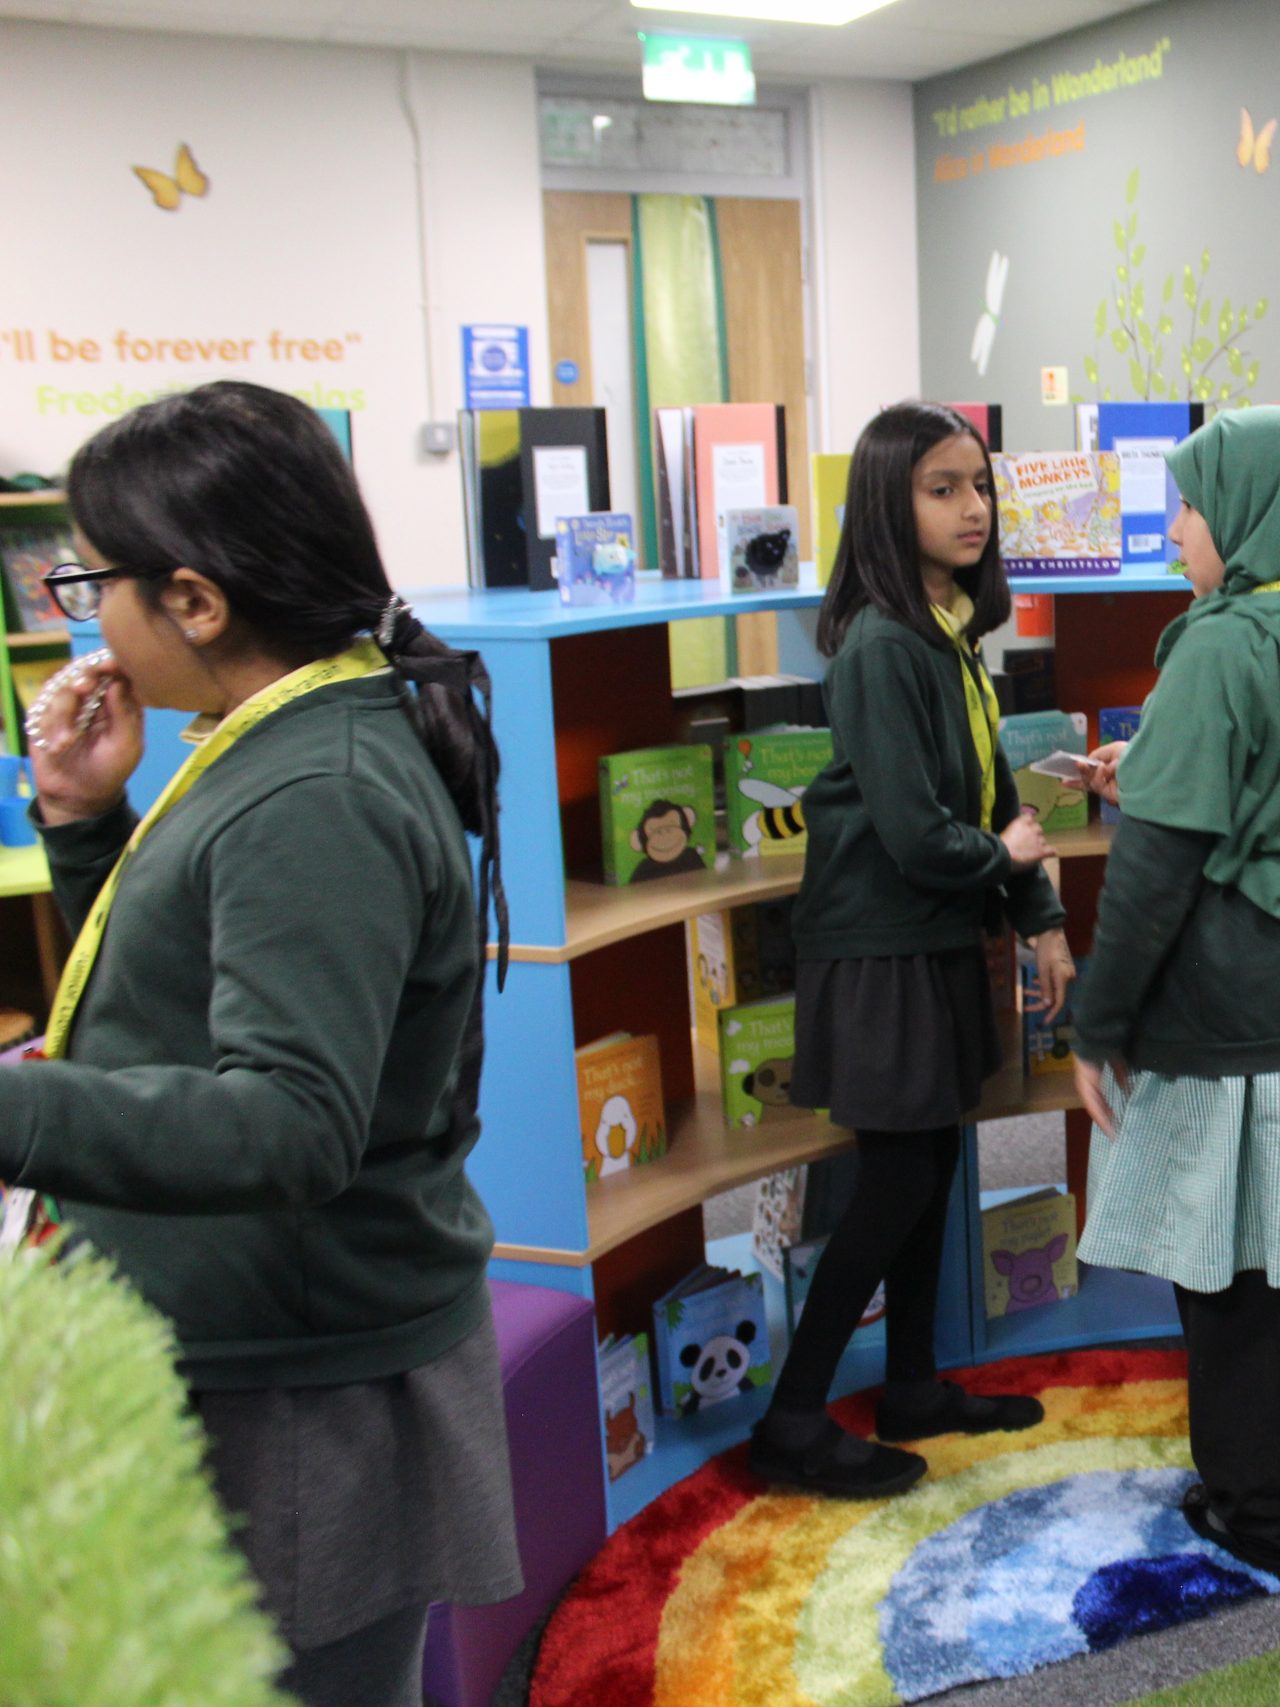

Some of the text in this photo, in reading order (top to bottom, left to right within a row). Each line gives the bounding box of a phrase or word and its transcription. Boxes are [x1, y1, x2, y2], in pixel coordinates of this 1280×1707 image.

[47, 328, 101, 363] be
[113, 329, 256, 363] forever
[268, 328, 362, 363] free"
[1015, 461, 1048, 478] FIVE
[1018, 468, 1092, 490] MONKEYS
